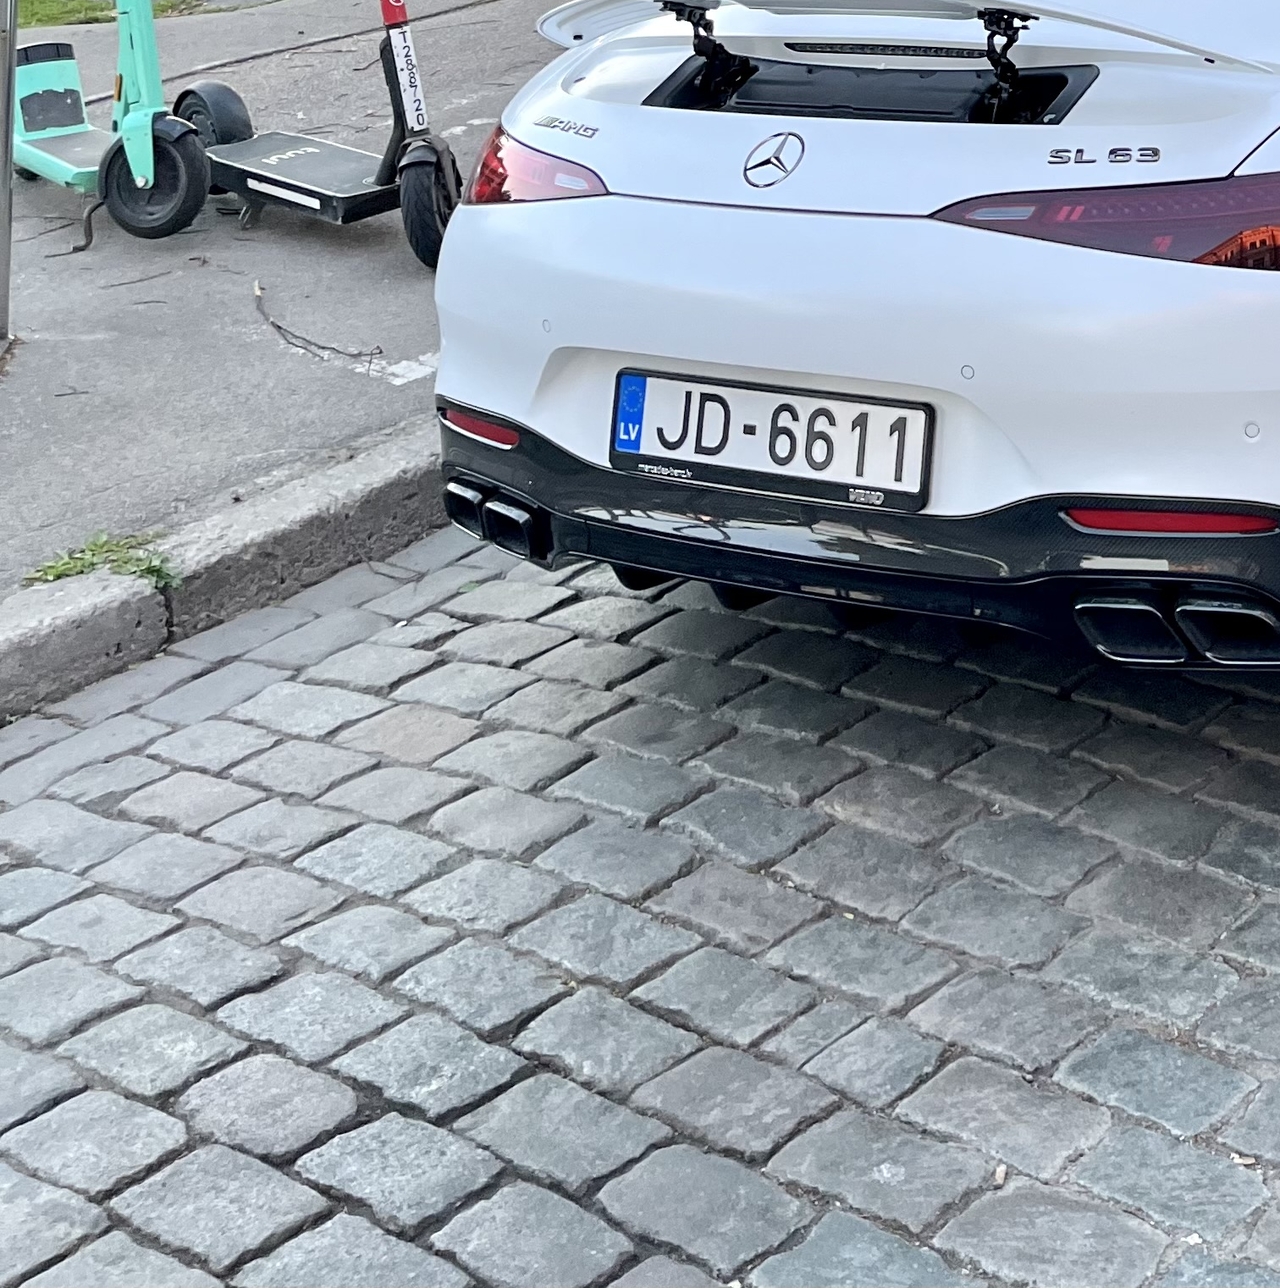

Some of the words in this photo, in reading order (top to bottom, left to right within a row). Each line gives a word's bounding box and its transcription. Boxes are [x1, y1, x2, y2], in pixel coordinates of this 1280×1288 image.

[398, 30, 425, 126] T288720
[1047, 148, 1097, 164] SL
[1108, 147, 1160, 163] 63
[618, 421, 640, 442] LV
[656, 390, 907, 482] JD-6611
